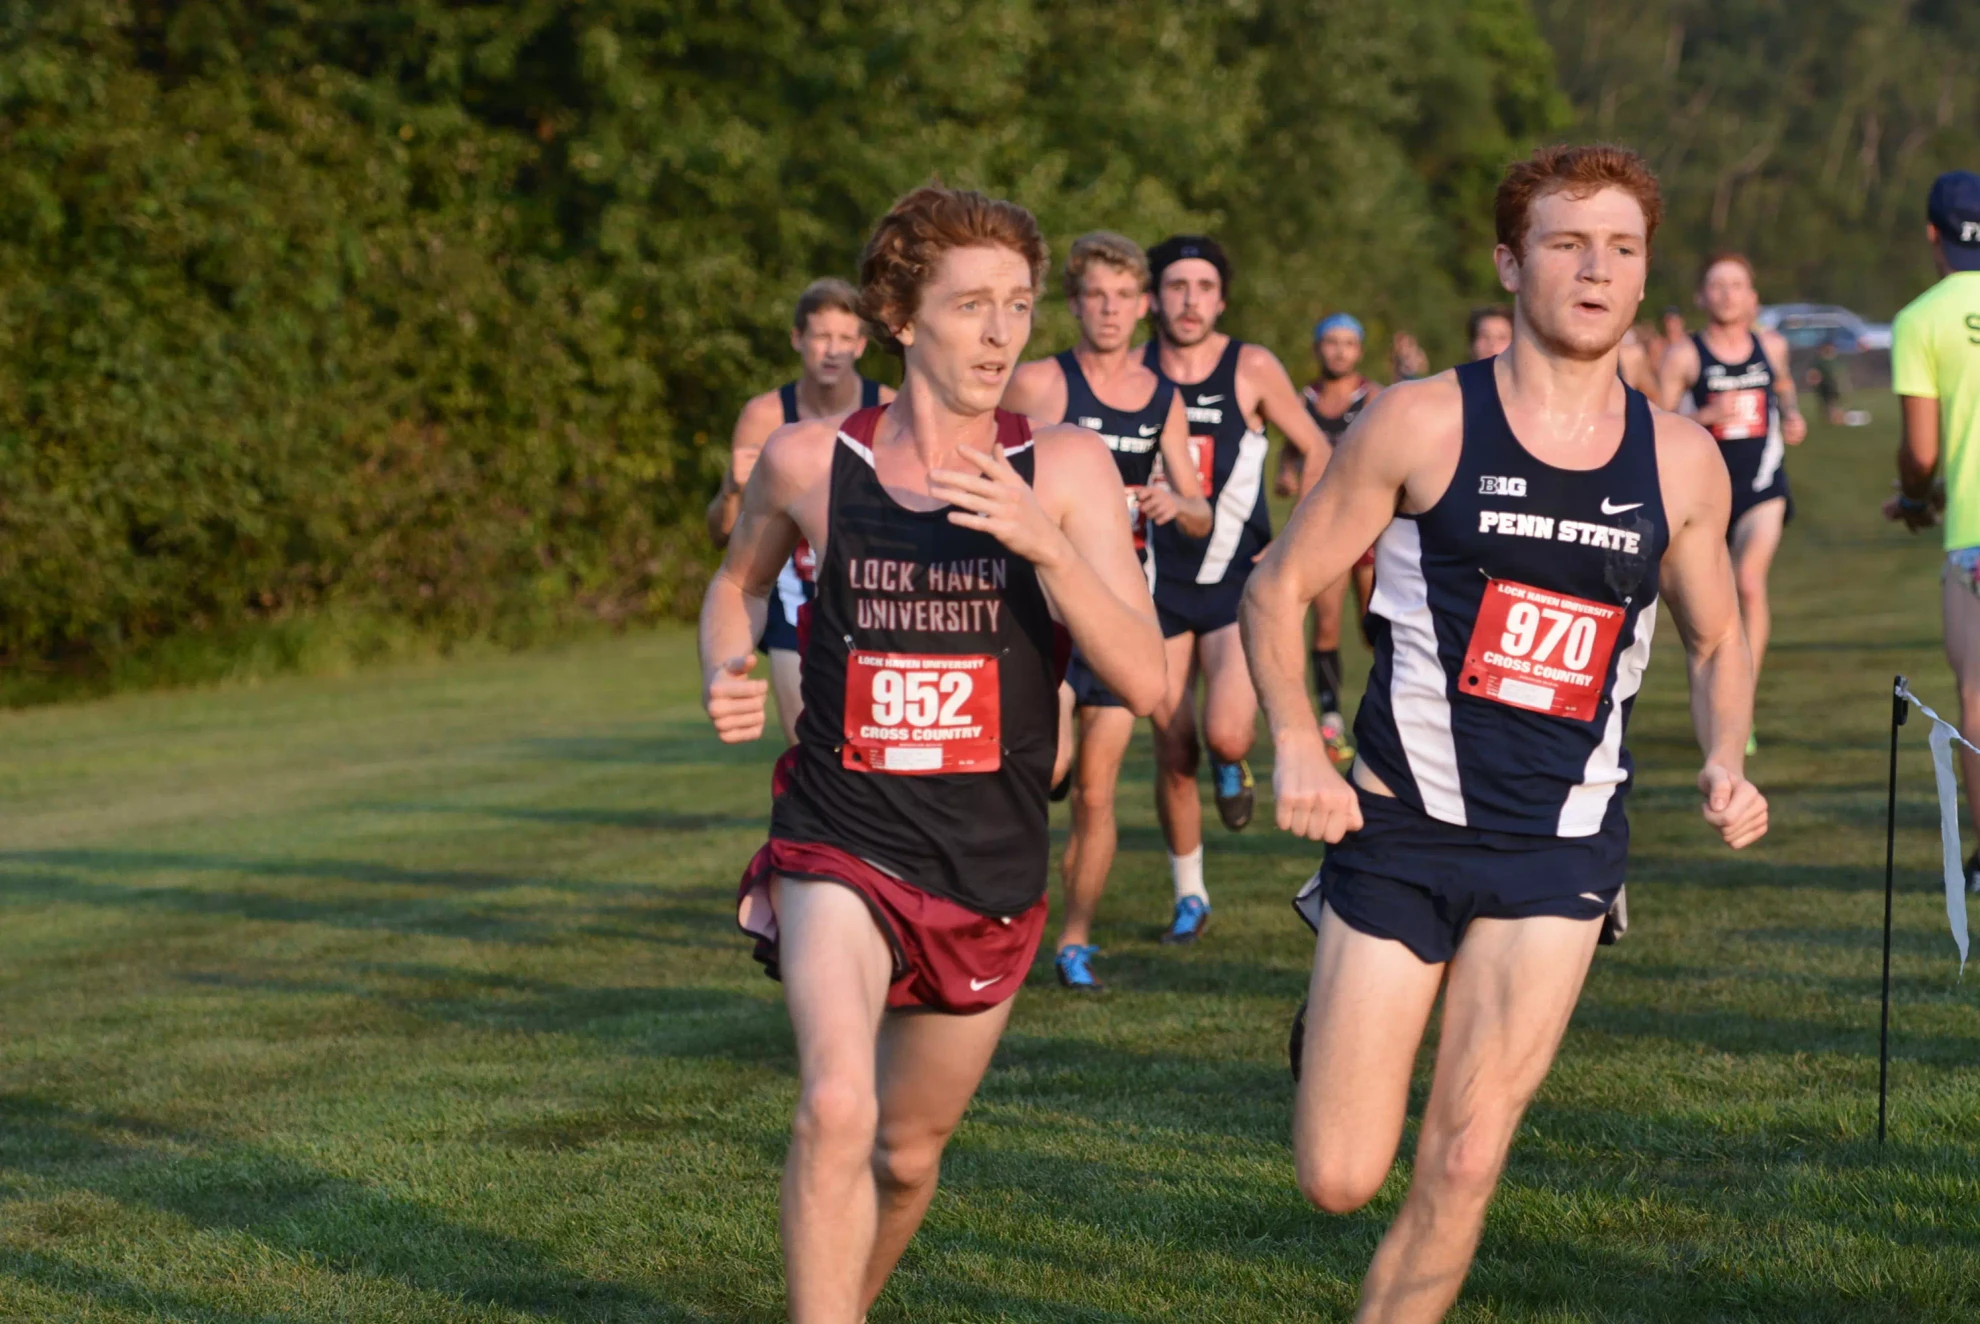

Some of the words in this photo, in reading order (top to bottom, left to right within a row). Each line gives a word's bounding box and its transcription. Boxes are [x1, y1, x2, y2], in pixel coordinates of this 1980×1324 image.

[1478, 511, 1555, 540] PENN
[1557, 520, 1641, 554] STATE
[849, 558, 915, 592] LOCK
[928, 558, 1007, 592] HAVEN
[857, 599, 1000, 633] UNIVERSITY
[1498, 584, 1526, 599] LOCK
[1527, 591, 1560, 608] HAVEN
[1560, 598, 1614, 619] UNIVERSITY
[1500, 602, 1597, 671] 970
[858, 656, 884, 667] LOCK
[885, 657, 920, 669] HAVEN
[922, 658, 985, 670] UNIVERSITY
[1483, 651, 1531, 674] CROSS
[1532, 665, 1593, 687] COUNTRY
[871, 670, 974, 727] 952
[860, 725, 909, 741] CROSS
[912, 725, 983, 741] COUNTRY
